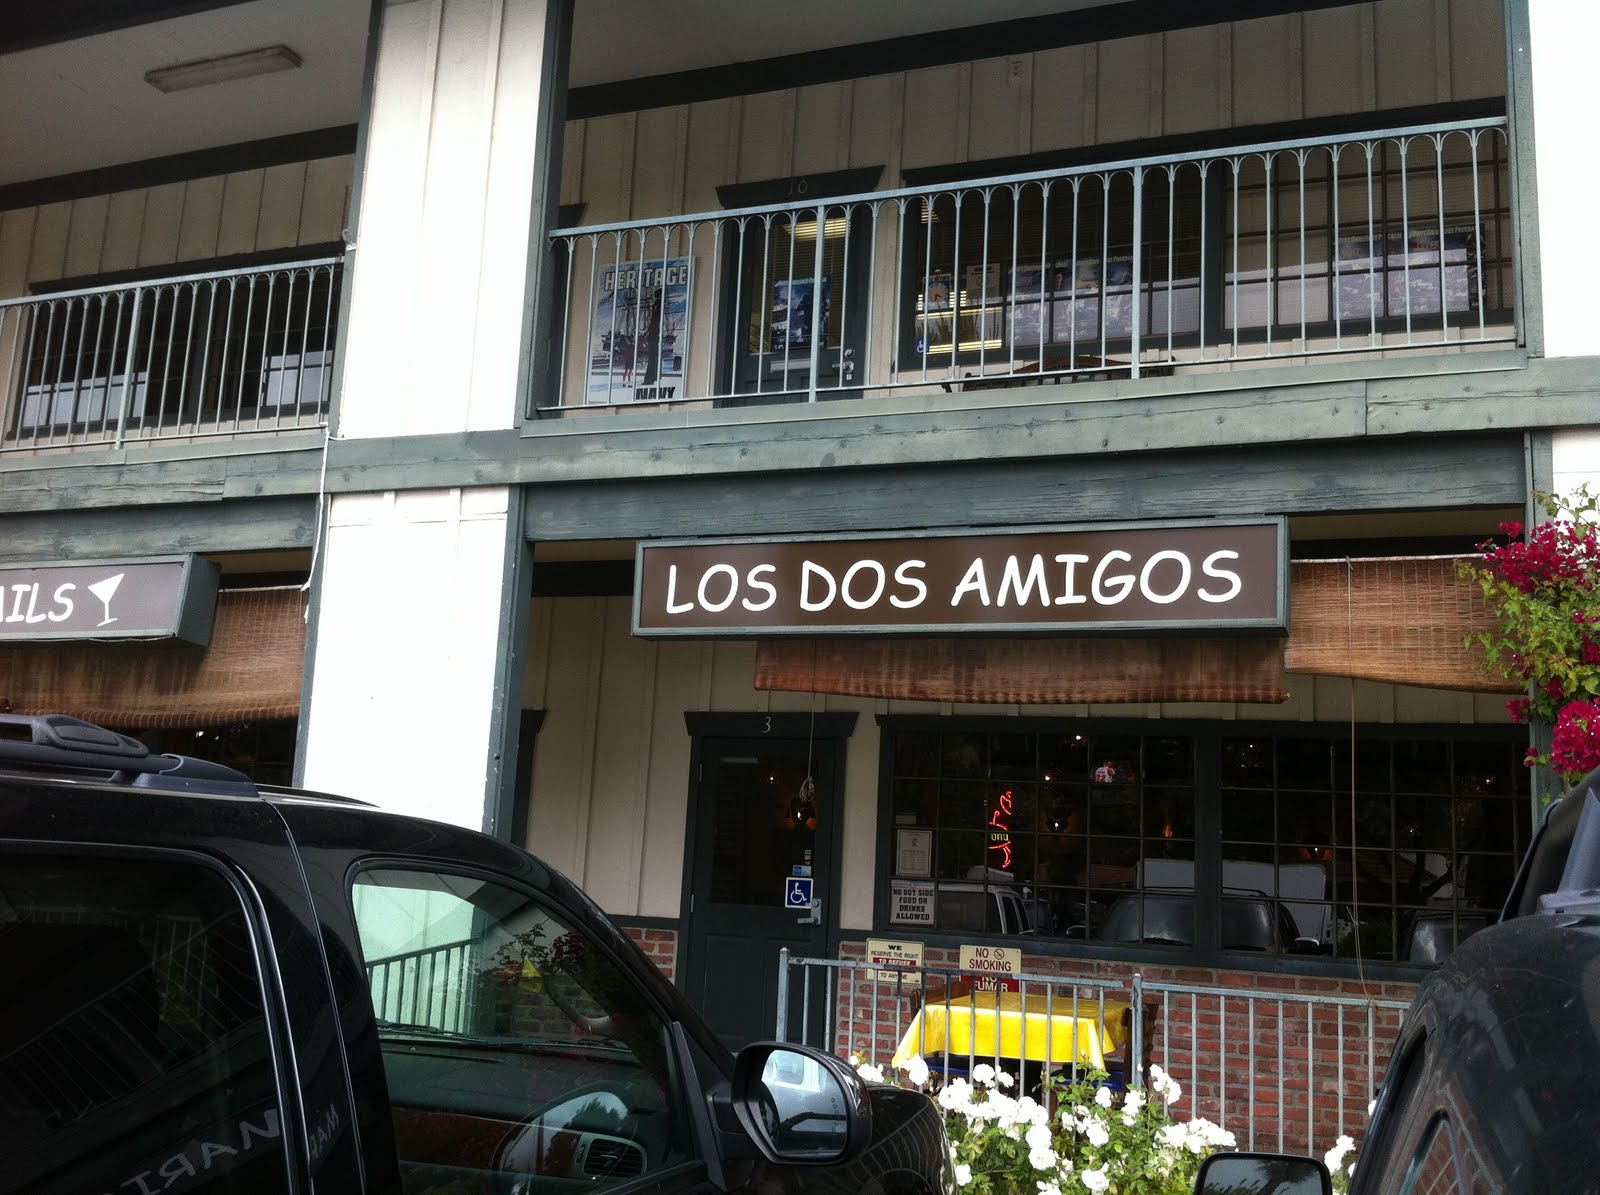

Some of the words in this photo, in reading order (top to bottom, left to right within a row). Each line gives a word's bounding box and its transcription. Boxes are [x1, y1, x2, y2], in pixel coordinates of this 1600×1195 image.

[666, 564, 776, 613] LOS
[800, 560, 927, 611] DOS
[951, 550, 1241, 607] AMIGOS
[0, 582, 76, 623] ILS
[760, 716, 771, 733] 3
[975, 948, 989, 958] NO
[969, 958, 1012, 972] SMOKING
[888, 972, 907, 980] ANYNE
